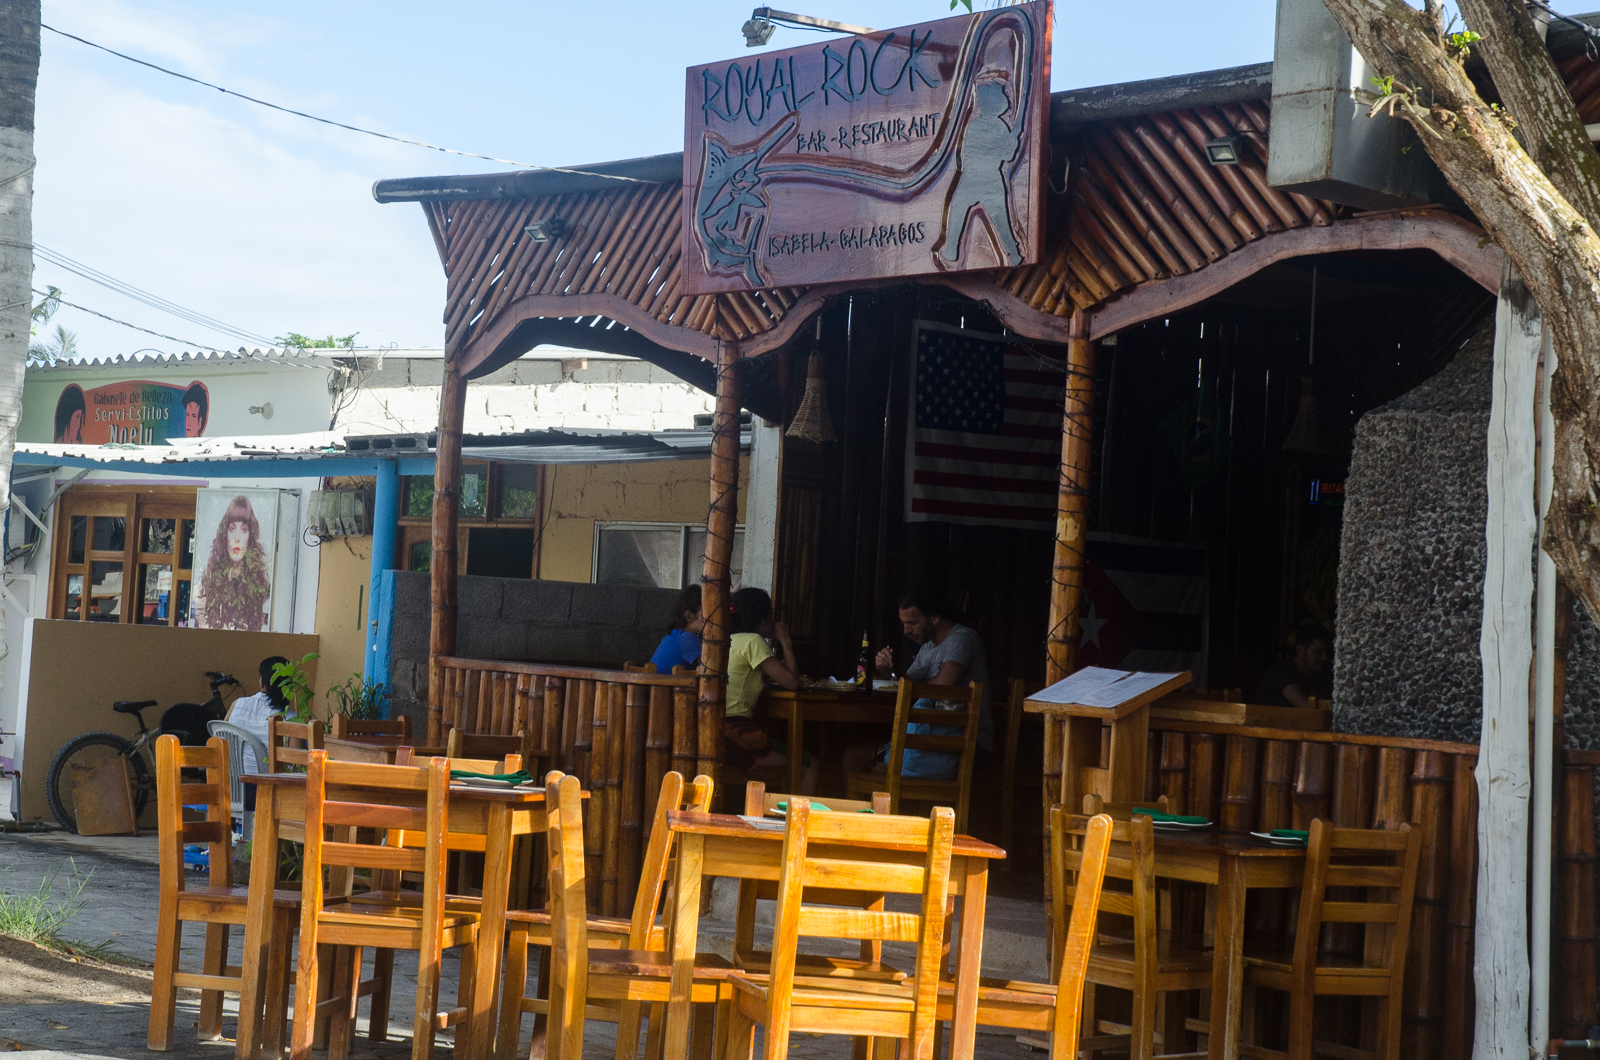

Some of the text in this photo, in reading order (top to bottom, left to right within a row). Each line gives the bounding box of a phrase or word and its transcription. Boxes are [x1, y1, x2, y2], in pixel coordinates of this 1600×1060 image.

[702, 29, 941, 126] ROYAL ROCK
[129, 391, 140, 404] de
